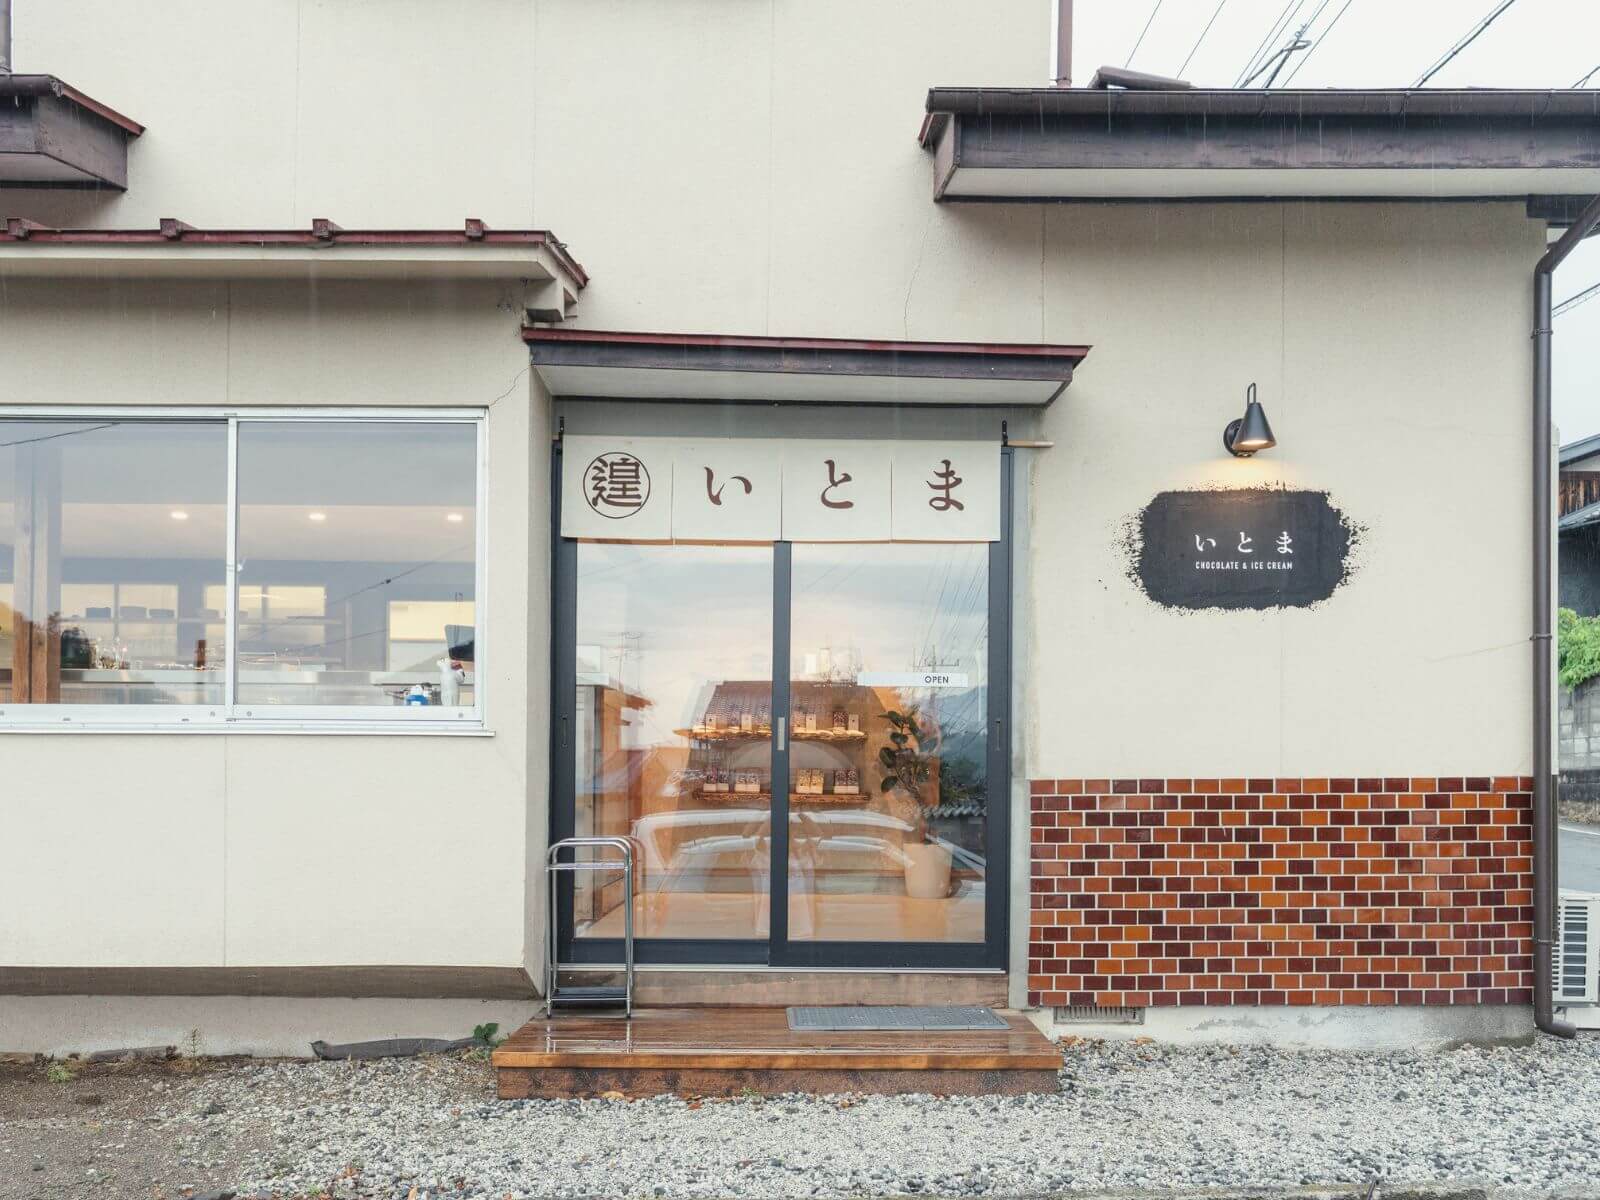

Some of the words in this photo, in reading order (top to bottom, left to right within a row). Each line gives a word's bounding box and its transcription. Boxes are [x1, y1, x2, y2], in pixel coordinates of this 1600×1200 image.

[1195, 531, 1294, 554] いとま
[1195, 561, 1240, 570] CHOCOLATE
[1242, 561, 1248, 570] &
[1251, 561, 1264, 570] ICE
[1266, 561, 1293, 570] CREAM
[924, 675, 949, 684] OPEN
